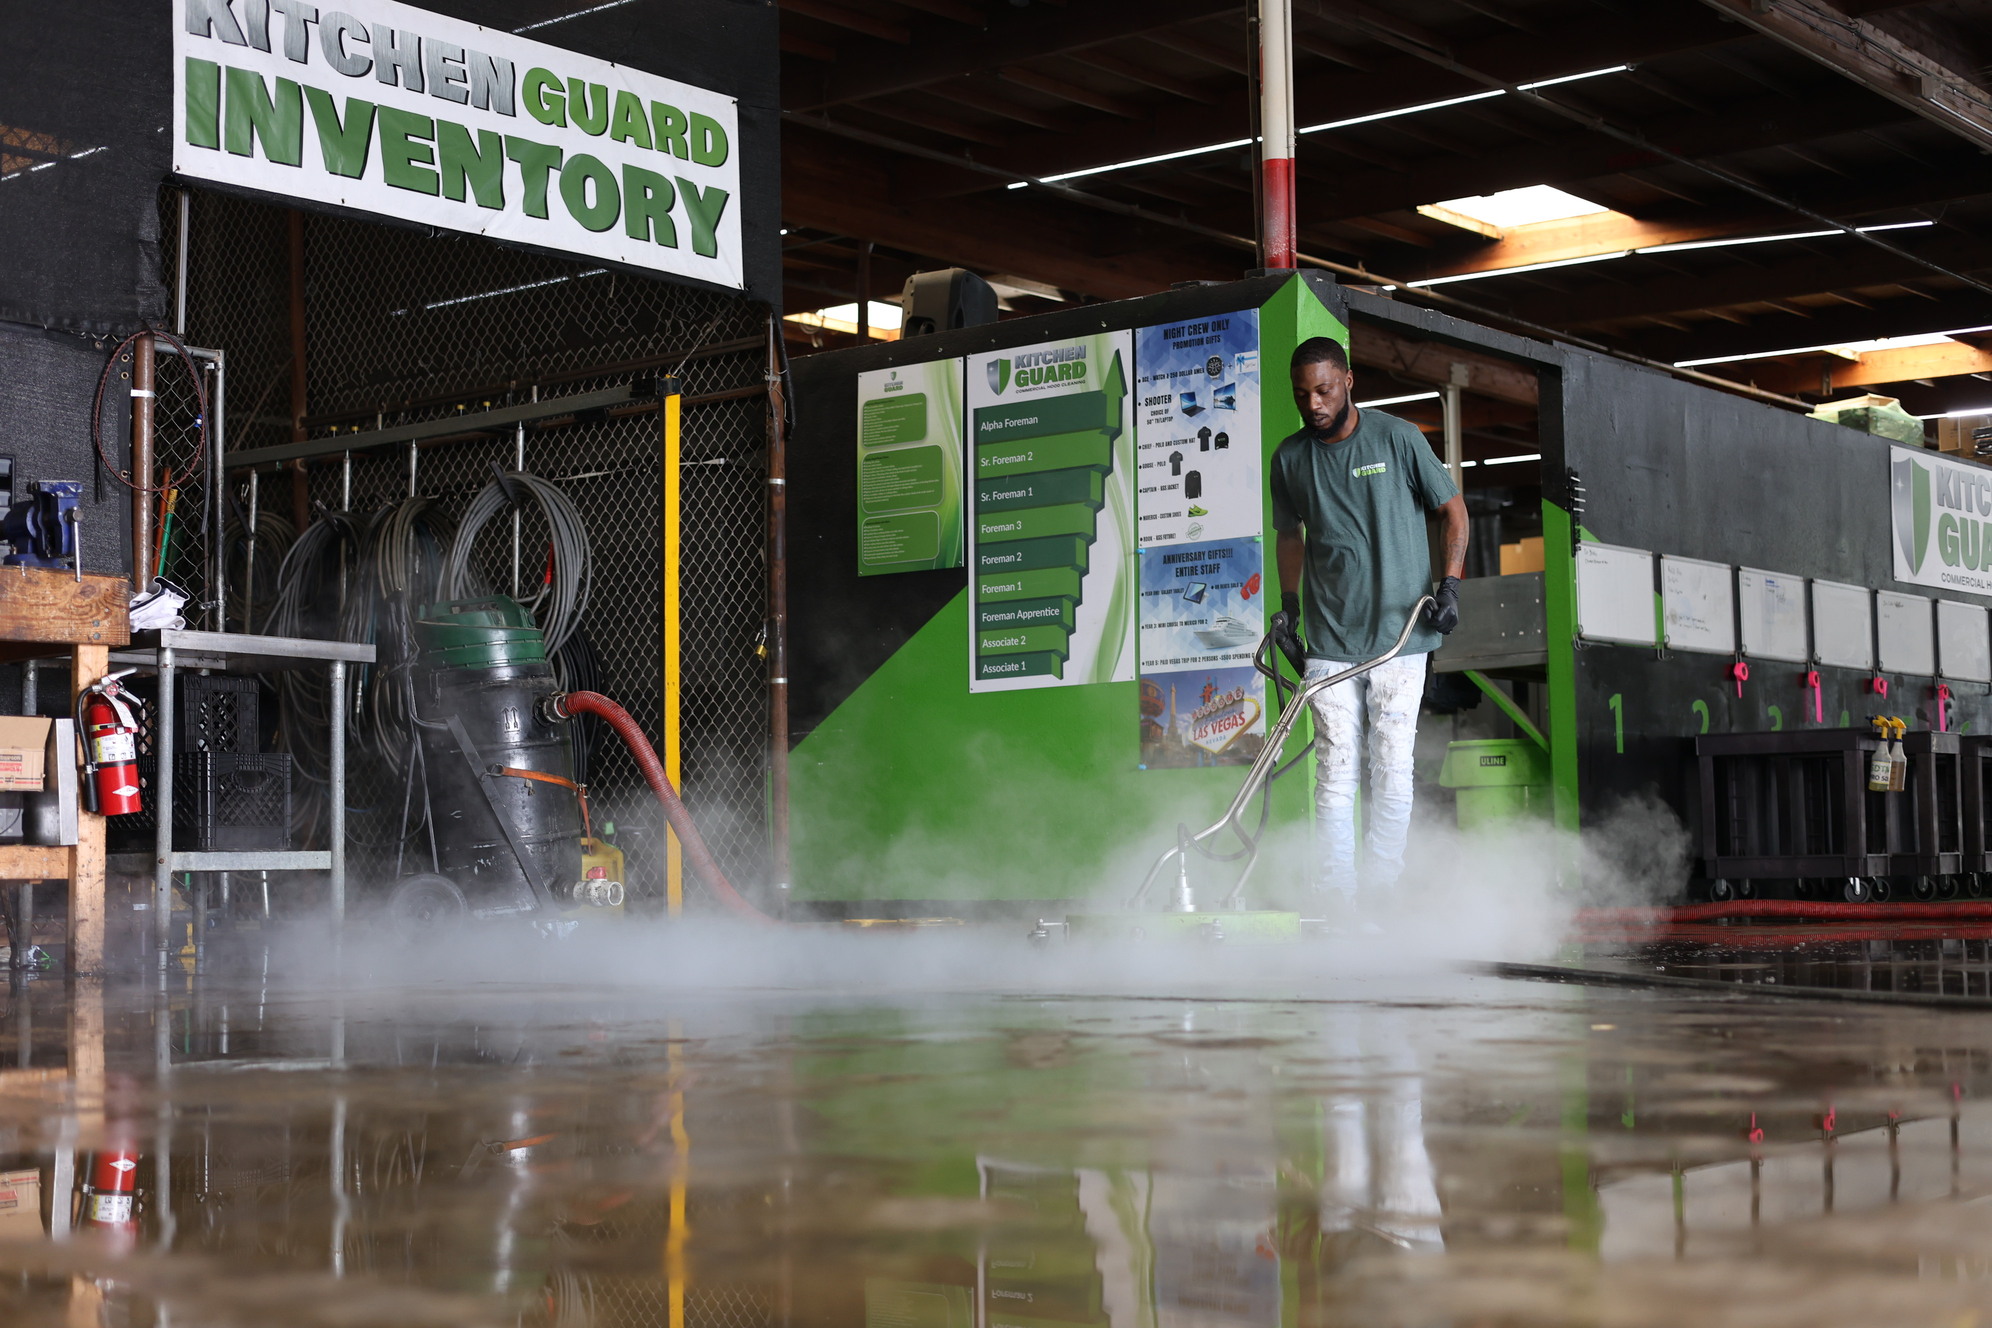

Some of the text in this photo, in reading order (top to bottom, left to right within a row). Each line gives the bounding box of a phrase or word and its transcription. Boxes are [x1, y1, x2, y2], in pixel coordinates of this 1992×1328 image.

[185, 0, 729, 167] KITCHEN GUARD
[185, 56, 730, 259] INVENTORY
[1163, 319, 1230, 340] NIGHT CREW ONLY
[1172, 337, 1205, 350] PROMOTION
[1014, 345, 1087, 369] KITCHEN
[1014, 361, 1087, 388] GUARD
[1015, 386, 1046, 394] COMMERCIAL
[1061, 379, 1086, 387] CLEANING
[1144, 394, 1172, 407] SHOOTER
[981, 416, 1038, 432] Alpha Foreman
[981, 452, 1033, 467] Sr. Foreman 2
[1361, 467, 1387, 476] GUARD
[981, 487, 1033, 501] Sr. Foreman 1
[1936, 464, 1992, 517] KITC
[981, 521, 1022, 534] Foreman 3
[981, 552, 1022, 565] Foreman 2
[1163, 548, 1233, 565] ANNIVERSARY GIFTS!!!
[1175, 563, 1221, 578] ENTIRE STAFF
[982, 582, 1022, 594] Foreman 1
[1941, 572, 1985, 590] COMMERCIAL
[982, 606, 1060, 622] Foreman Apprentice
[982, 636, 1026, 648] Associate 2
[982, 661, 1026, 674] Associate 1
[1193, 725, 1209, 741] LAS
[1211, 711, 1246, 735] VEGAS
[1608, 693, 1624, 754] 1
[1480, 756, 1505, 766] ULINE
